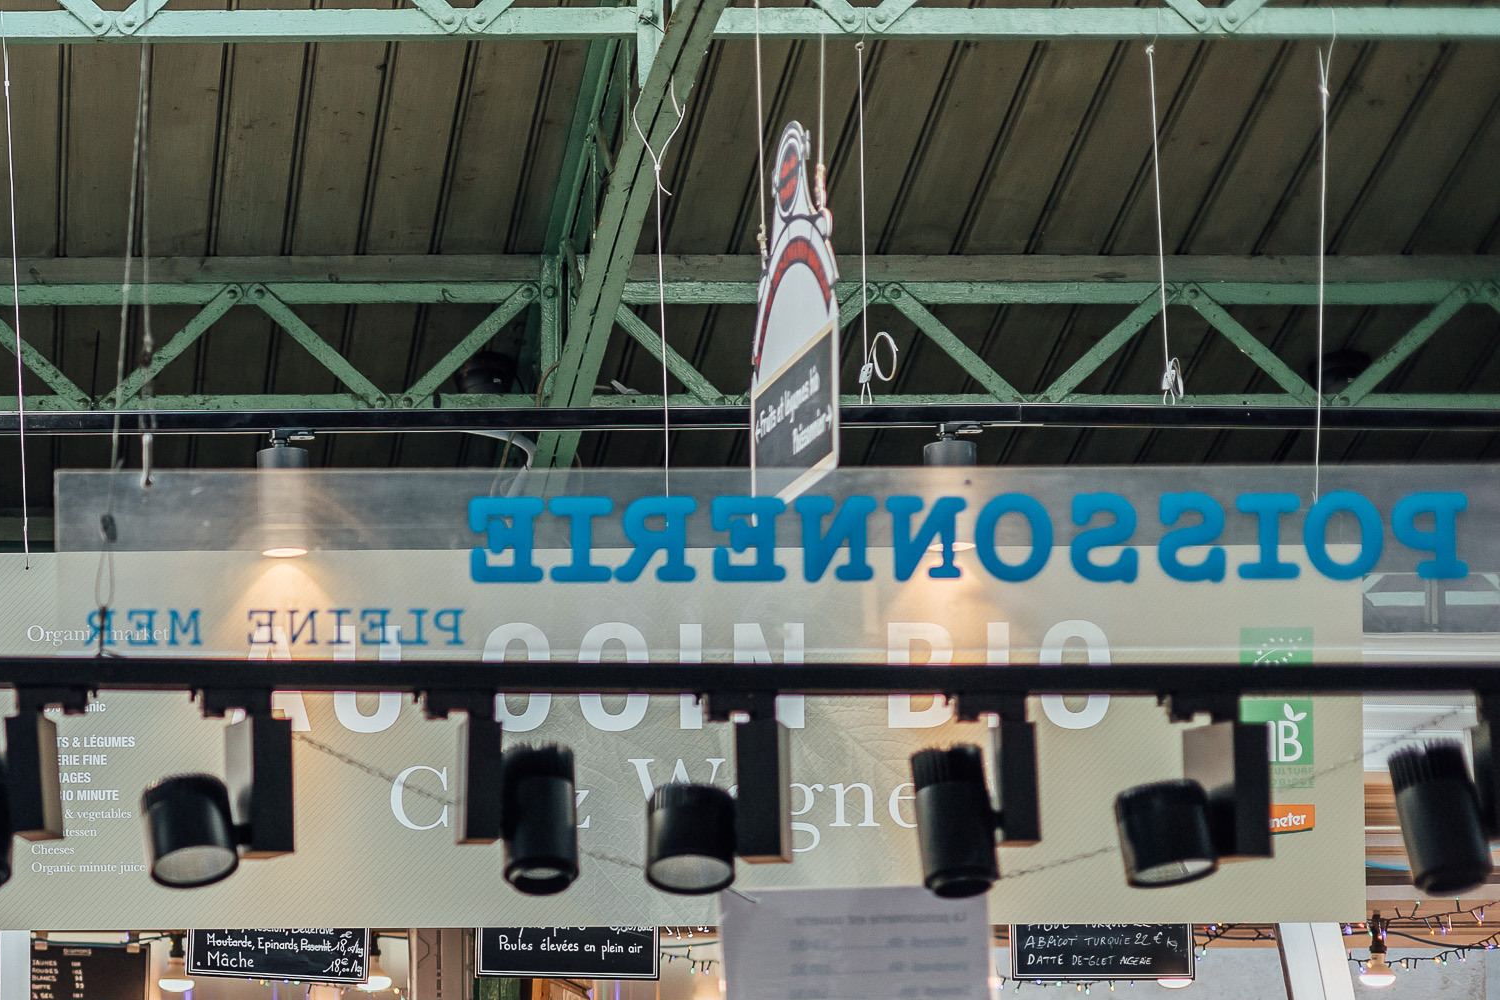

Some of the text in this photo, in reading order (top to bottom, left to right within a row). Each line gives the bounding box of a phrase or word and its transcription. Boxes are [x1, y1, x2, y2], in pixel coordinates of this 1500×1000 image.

[112, 623, 169, 641] market
[84, 734, 136, 748] LÉGUMES
[83, 755, 107, 766] FINE
[77, 790, 119, 801] MINUTE
[77, 808, 132, 821] vegetables
[31, 844, 75, 855] Cheeses
[31, 862, 146, 875] Organic minute juice
[258, 937, 299, 954] Epinards,
[1134, 932, 1151, 946] 22
[1153, 932, 1163, 944] €
[499, 935, 643, 960] Poules élevées en plein air
[207, 951, 254, 968] Mâche
[1027, 954, 1064, 966] DATTE
